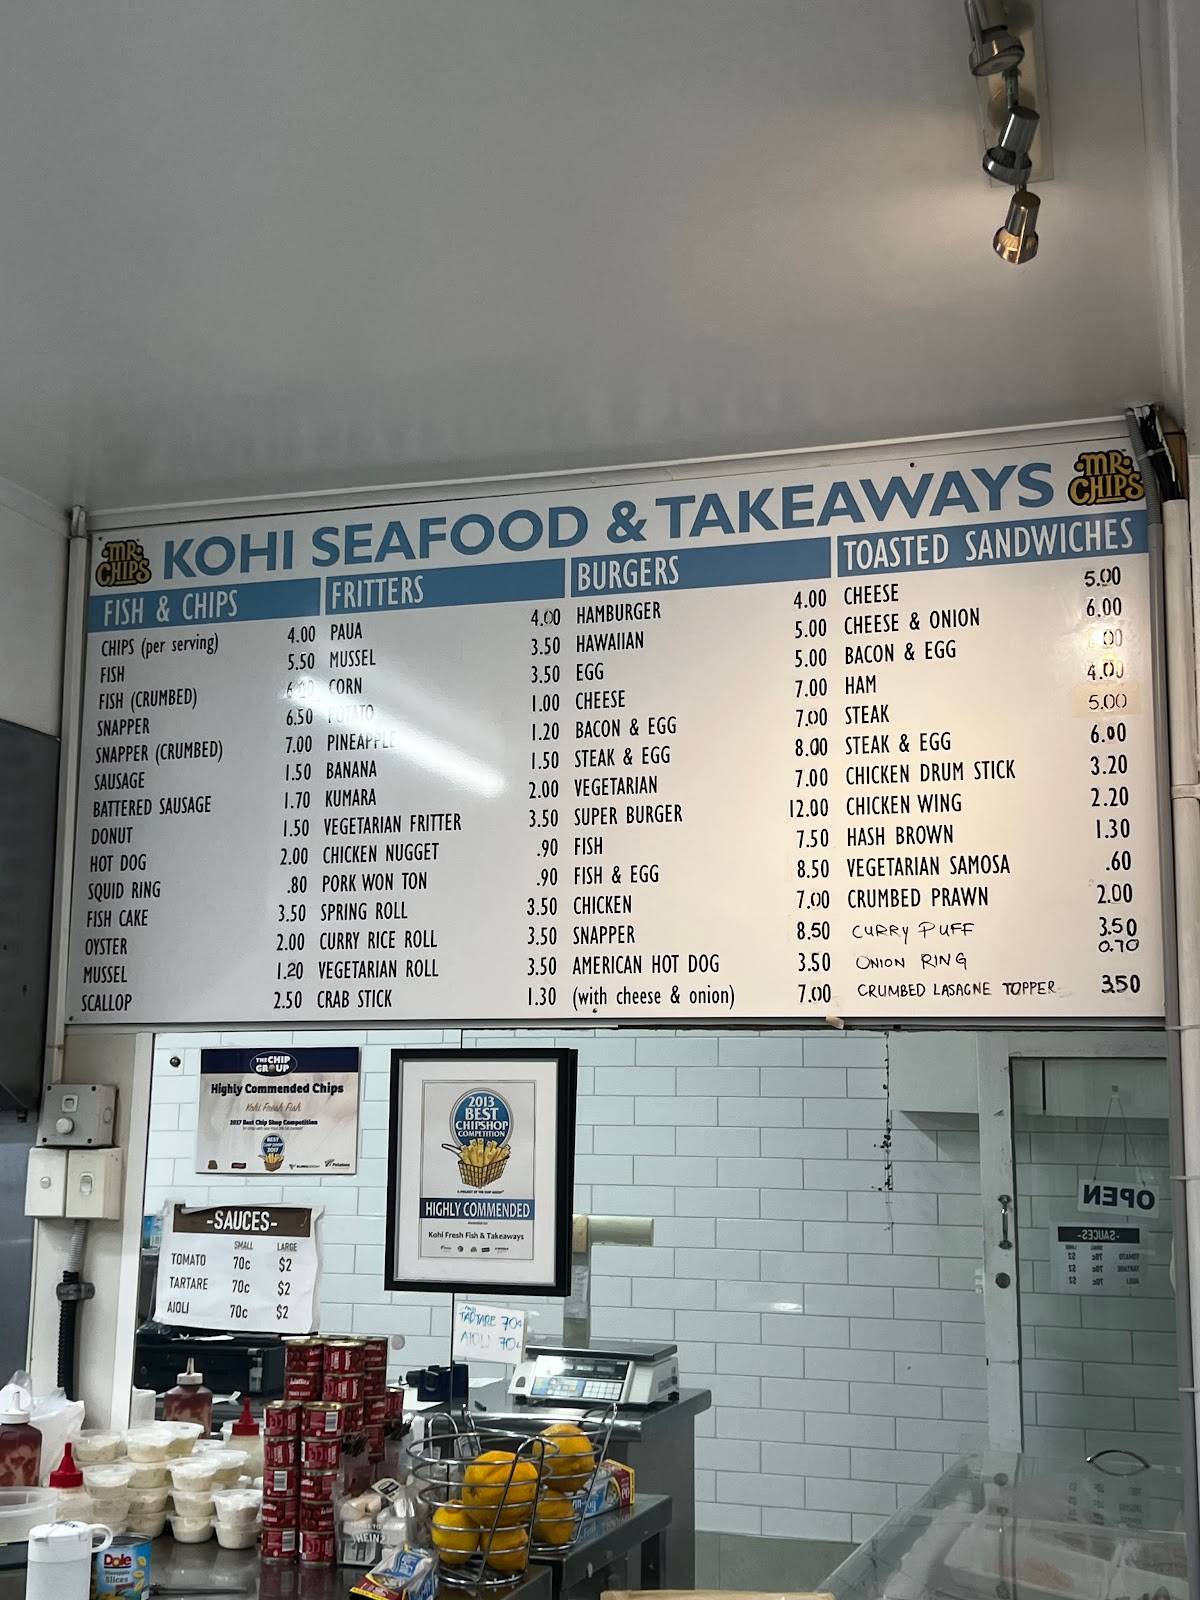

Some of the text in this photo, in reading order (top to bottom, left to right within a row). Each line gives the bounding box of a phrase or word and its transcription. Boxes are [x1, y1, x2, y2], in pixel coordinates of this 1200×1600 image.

[1068, 474, 1145, 506] CHIPS
[163, 462, 1054, 579] KOHI SEAFOOD & TAKEAWAYS
[843, 517, 1134, 571] TOASTED SANDWICHES
[96, 560, 152, 587] CHIPS
[578, 555, 679, 592] BURGERS
[331, 575, 424, 610] FRITTERS
[104, 590, 238, 626] FISH & CHIPS
[577, 589, 826, 624] HAMBURGER 4.00
[844, 597, 1121, 635] CHEESE & ONION 6.00
[331, 608, 560, 640] PAUA 4.00
[577, 618, 826, 652] HAWAIIAN 5.00
[102, 625, 315, 659] CHIPS (per serving) 4.00
[101, 653, 315, 683] FISH 5.50
[329, 665, 560, 694] CORN 3.50
[846, 660, 1123, 694] HAM 4.00
[97, 708, 313, 736] SNAPPER 6.50
[845, 693, 1127, 725] STEAK 5.00
[576, 708, 827, 739] BACON & EGG 7.00
[326, 751, 559, 779] BANANA 1.50
[846, 754, 1127, 785] CHICKEN DRUM STICK 3.20
[574, 768, 828, 797] VEGETARIAN 7.00
[93, 791, 310, 817] BATTERED SAUSAGE 1.70
[574, 798, 828, 826] SUPER BURGER 12.00
[324, 809, 558, 836] VEGETARIAN FRITTER 3.50
[90, 847, 308, 872] HOT DOG 2.00
[323, 838, 558, 864] CHICKEN NUGGET .90
[847, 851, 1131, 877] VEGETARIAN SAMOSA .60
[88, 876, 307, 902] SQUID RING .80
[574, 890, 829, 915] CHICKEN 7.00
[321, 897, 557, 921] SPRING ROLL 3.50
[85, 933, 304, 955] OYSTER 2.00
[852, 917, 1137, 944] CURRY PUFF 3.50
[572, 952, 830, 975] AMERICAN HOT DOG 3.50
[856, 939, 1139, 970] ONION RING 0.70
[82, 991, 302, 1011] SCALLOP 2.50
[317, 987, 556, 1008] CRAB STICK 1.30
[573, 984, 831, 1011] (with cheese & onion) 7.00
[857, 983, 926, 998] CRUMBED
[1002, 981, 1056, 995] TOPPER
[211, 1082, 344, 1096] Highly Commended Chips
[468, 1096, 495, 1108] 2013
[246, 1102, 302, 1112] Kohi Fresh Fish
[465, 1108, 498, 1120] BEST
[456, 1121, 508, 1130] CHIPSHOP
[206, 1209, 278, 1231] -SAUCES-
[426, 1202, 530, 1218] HIGHLY COMMENDED
[234, 1241, 297, 1251] SMALL LARGE
[428, 1231, 443, 1239] Kohi
[486, 1232, 524, 1240] Takeaways
[171, 1253, 292, 1272] TOMATO 70c $2
[170, 1276, 290, 1296] TARTARE 70c $2
[167, 1302, 288, 1320] AIOLI 70c $2
[104, 1554, 132, 1566] Dole
